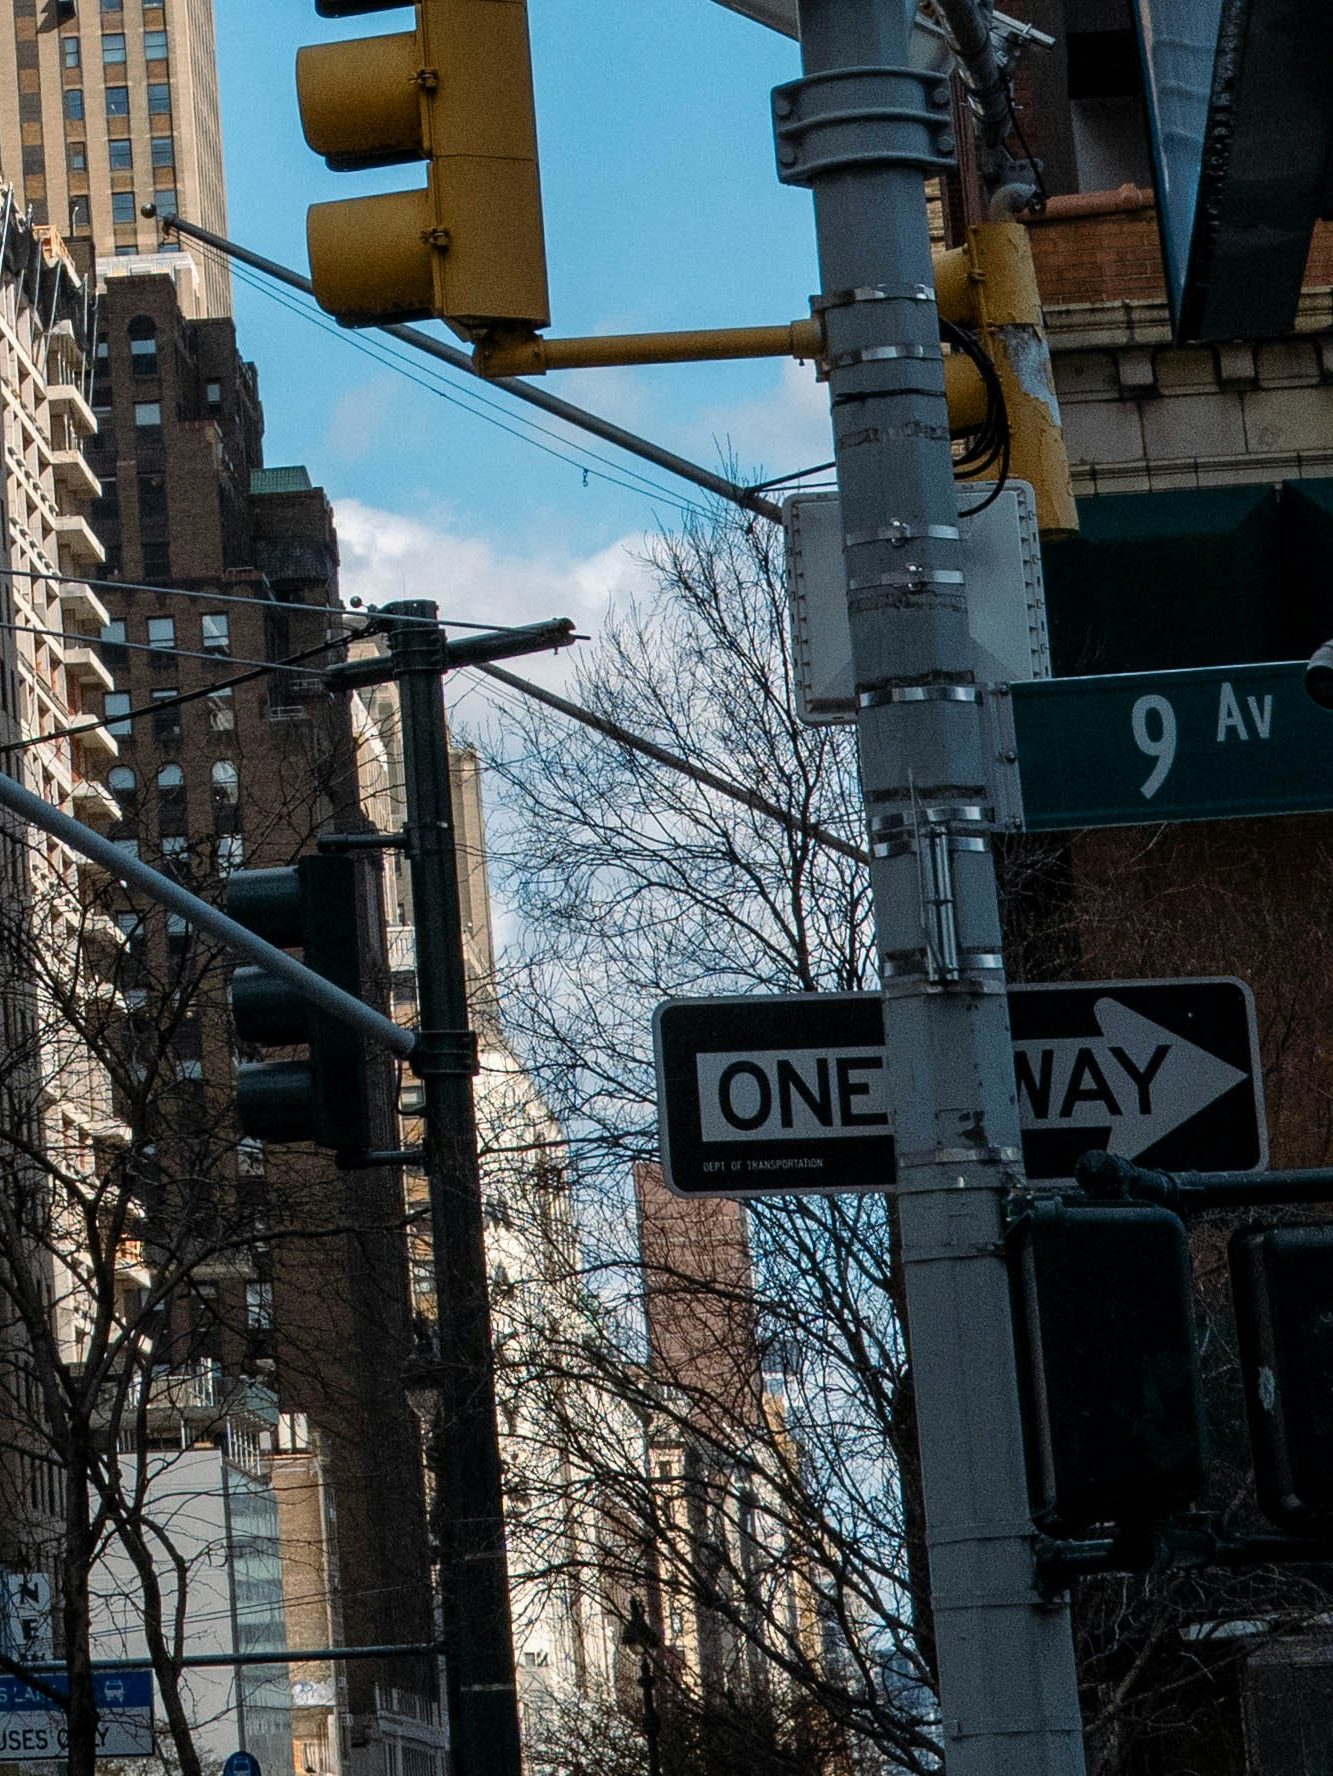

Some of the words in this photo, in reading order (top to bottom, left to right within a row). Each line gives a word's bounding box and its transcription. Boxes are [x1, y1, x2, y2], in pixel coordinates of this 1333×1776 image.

[1130, 693, 1178, 800] 9
[1216, 681, 1274, 742] Av
[715, 1054, 890, 1132] ONE
[746, 1157, 824, 1170] TRANSPORTATION
